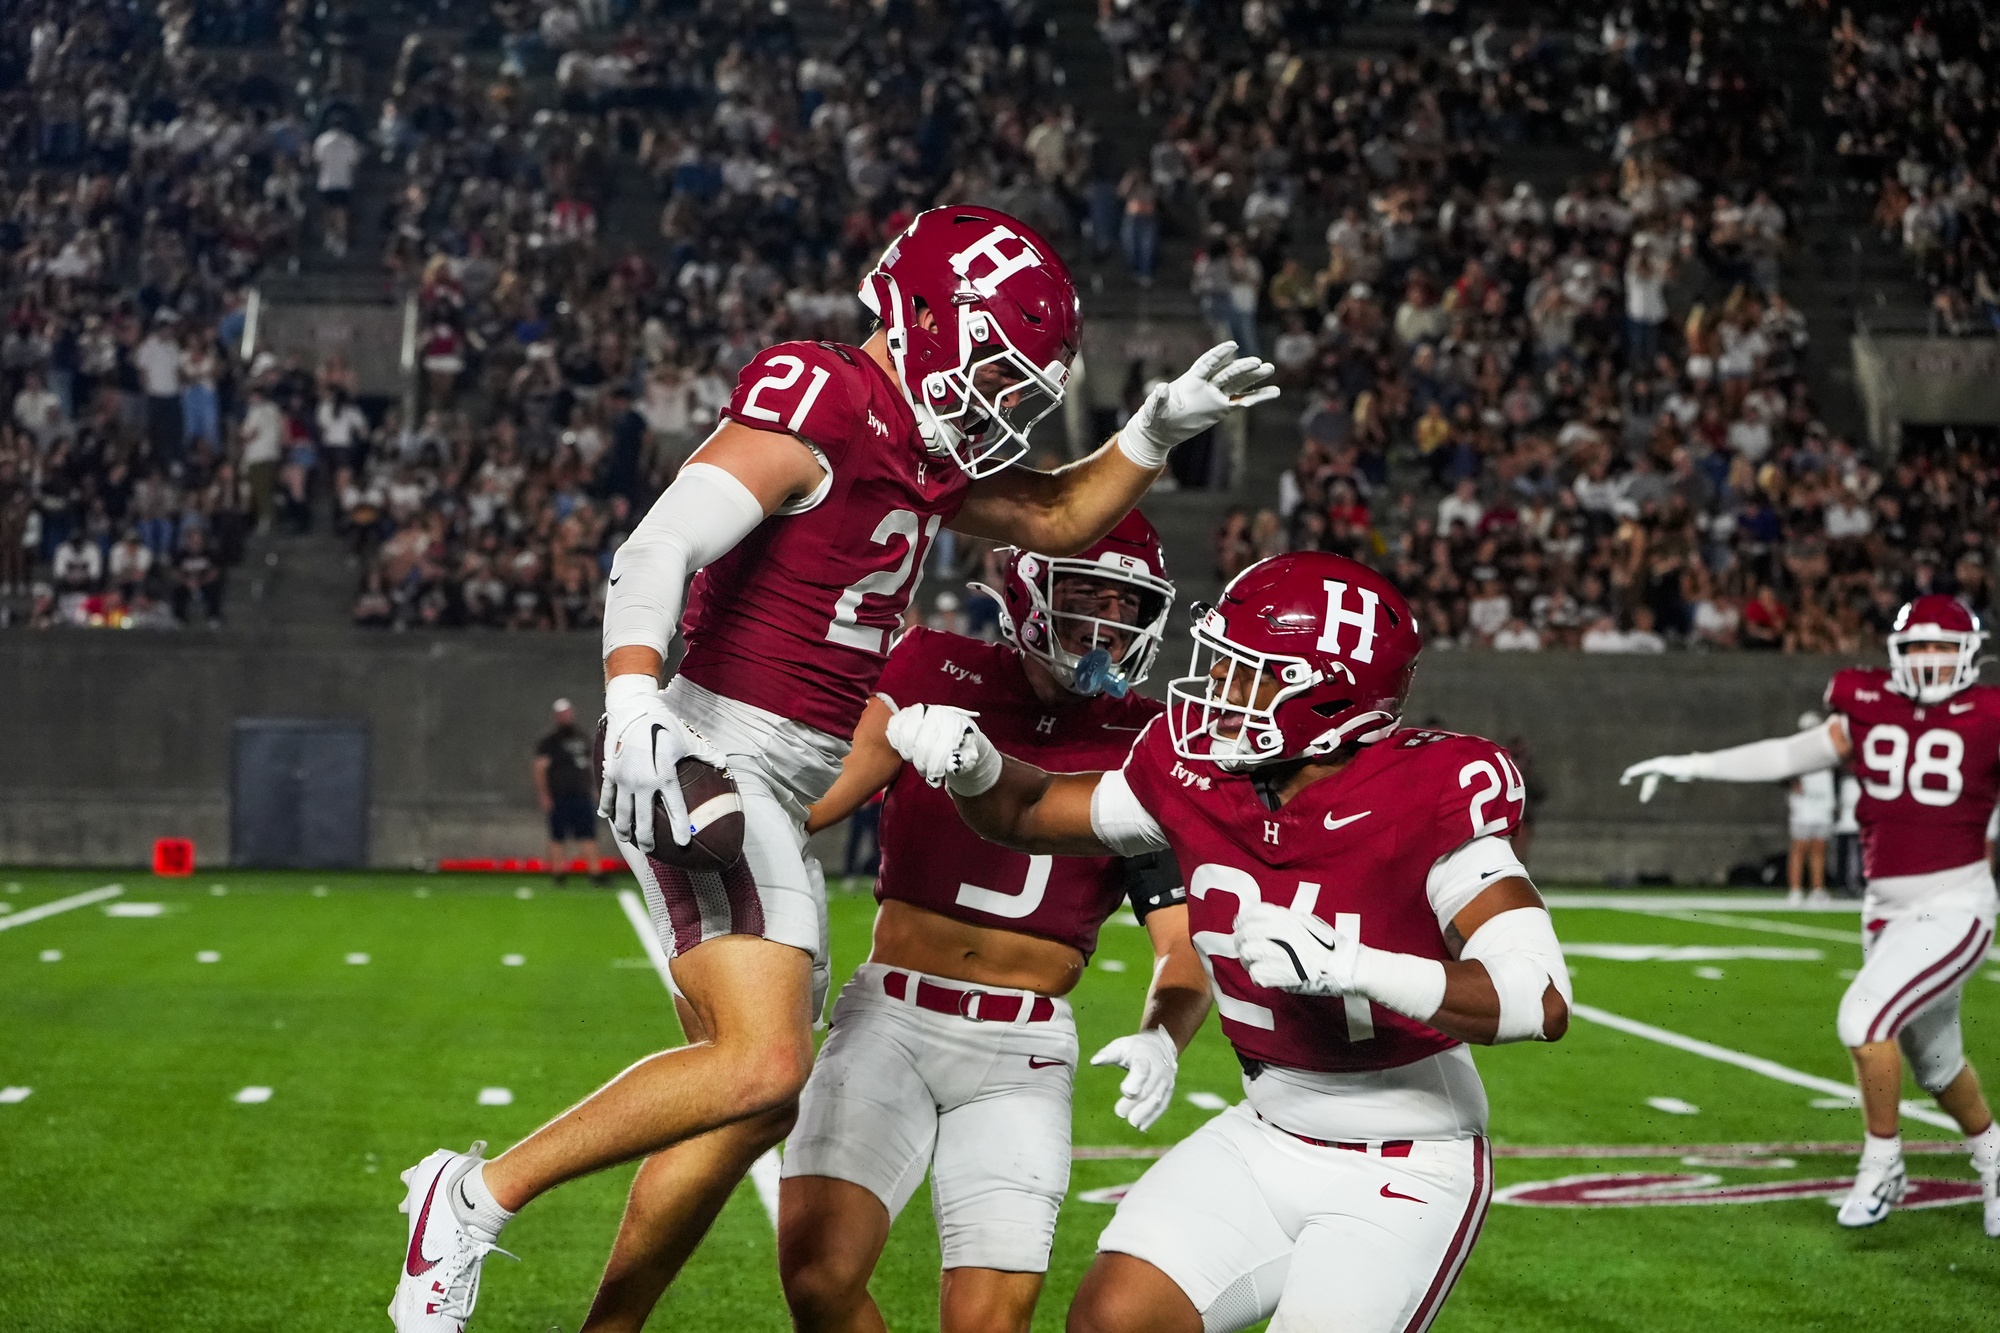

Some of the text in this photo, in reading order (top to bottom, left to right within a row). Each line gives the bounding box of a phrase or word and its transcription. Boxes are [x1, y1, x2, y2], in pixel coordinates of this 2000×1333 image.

[948, 225, 1042, 299] H
[741, 355, 831, 433] 21
[867, 409, 882, 437] Ivy
[917, 462, 927, 485] H
[1316, 579, 1379, 664] H
[941, 660, 970, 681] Ivy
[1036, 715, 1057, 734] H
[1169, 761, 1199, 787] Ivy
[1863, 724, 1964, 806] 98
[1459, 751, 1526, 838] 24
[1263, 820, 1280, 845] H
